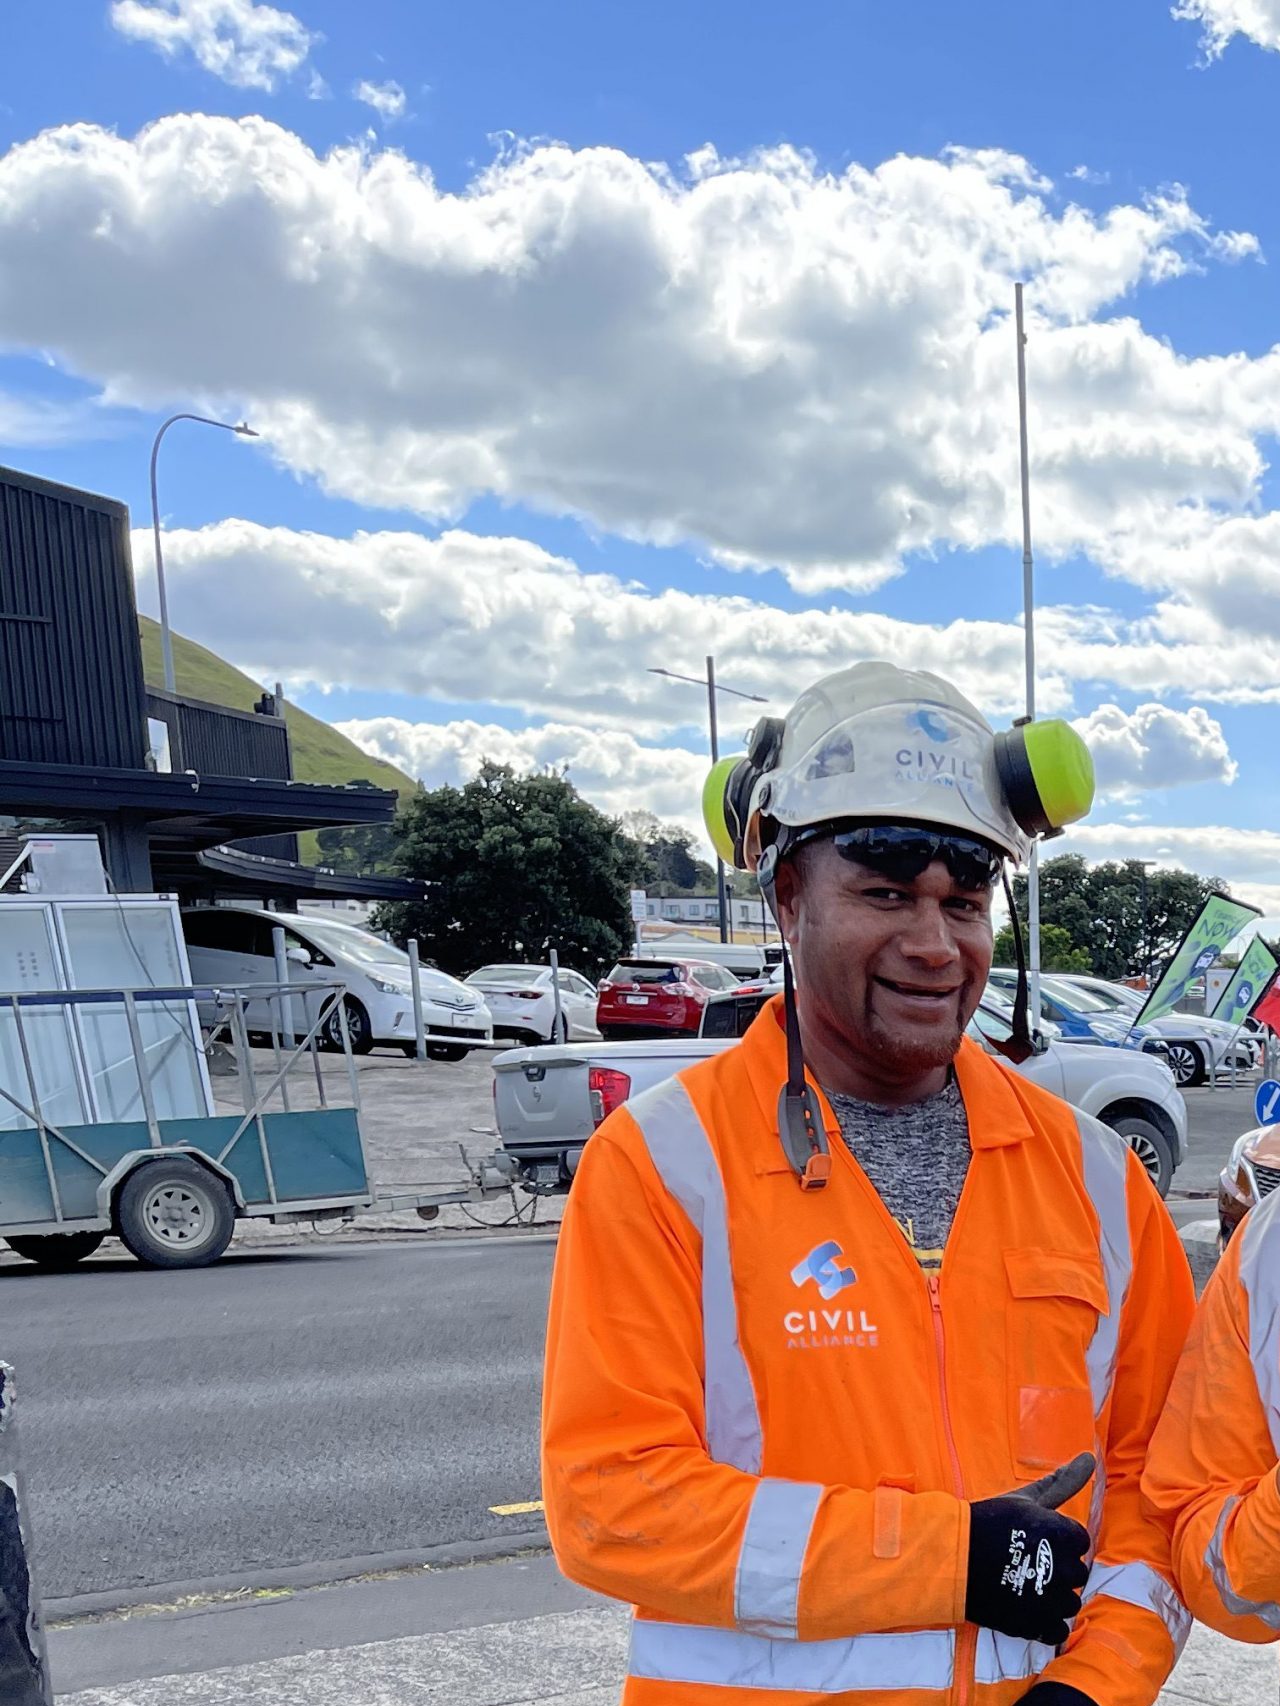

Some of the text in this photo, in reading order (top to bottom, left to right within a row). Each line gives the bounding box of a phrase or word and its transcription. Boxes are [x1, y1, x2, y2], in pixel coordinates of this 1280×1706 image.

[895, 748, 974, 780] CIVIL
[783, 1310, 878, 1335] CIVIL
[786, 1335, 880, 1350] ALLIANCE
